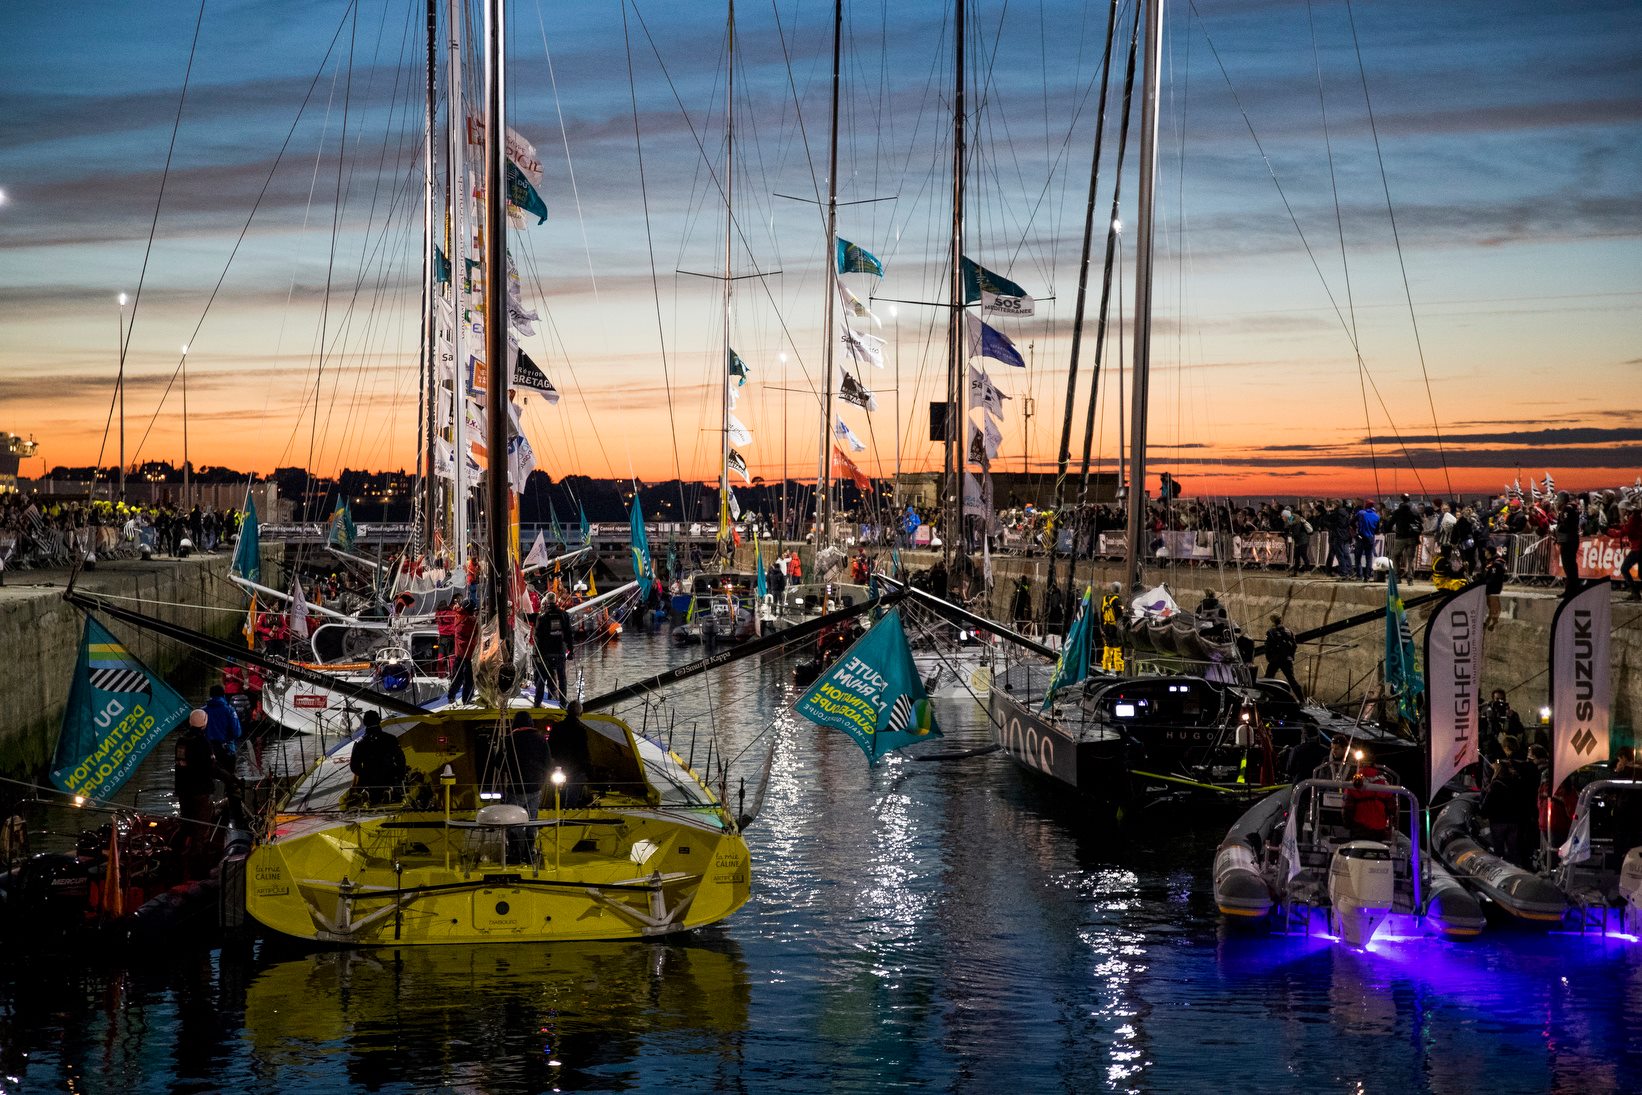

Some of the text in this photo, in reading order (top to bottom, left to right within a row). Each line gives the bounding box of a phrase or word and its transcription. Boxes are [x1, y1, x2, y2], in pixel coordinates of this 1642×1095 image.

[995, 298, 1022, 310] SOS
[710, 652, 730, 663] Kappa
[1575, 609, 1594, 722] SUZUKI
[1451, 610, 1471, 742] HIGHFIELD
[1166, 731, 1214, 740] HUGO
